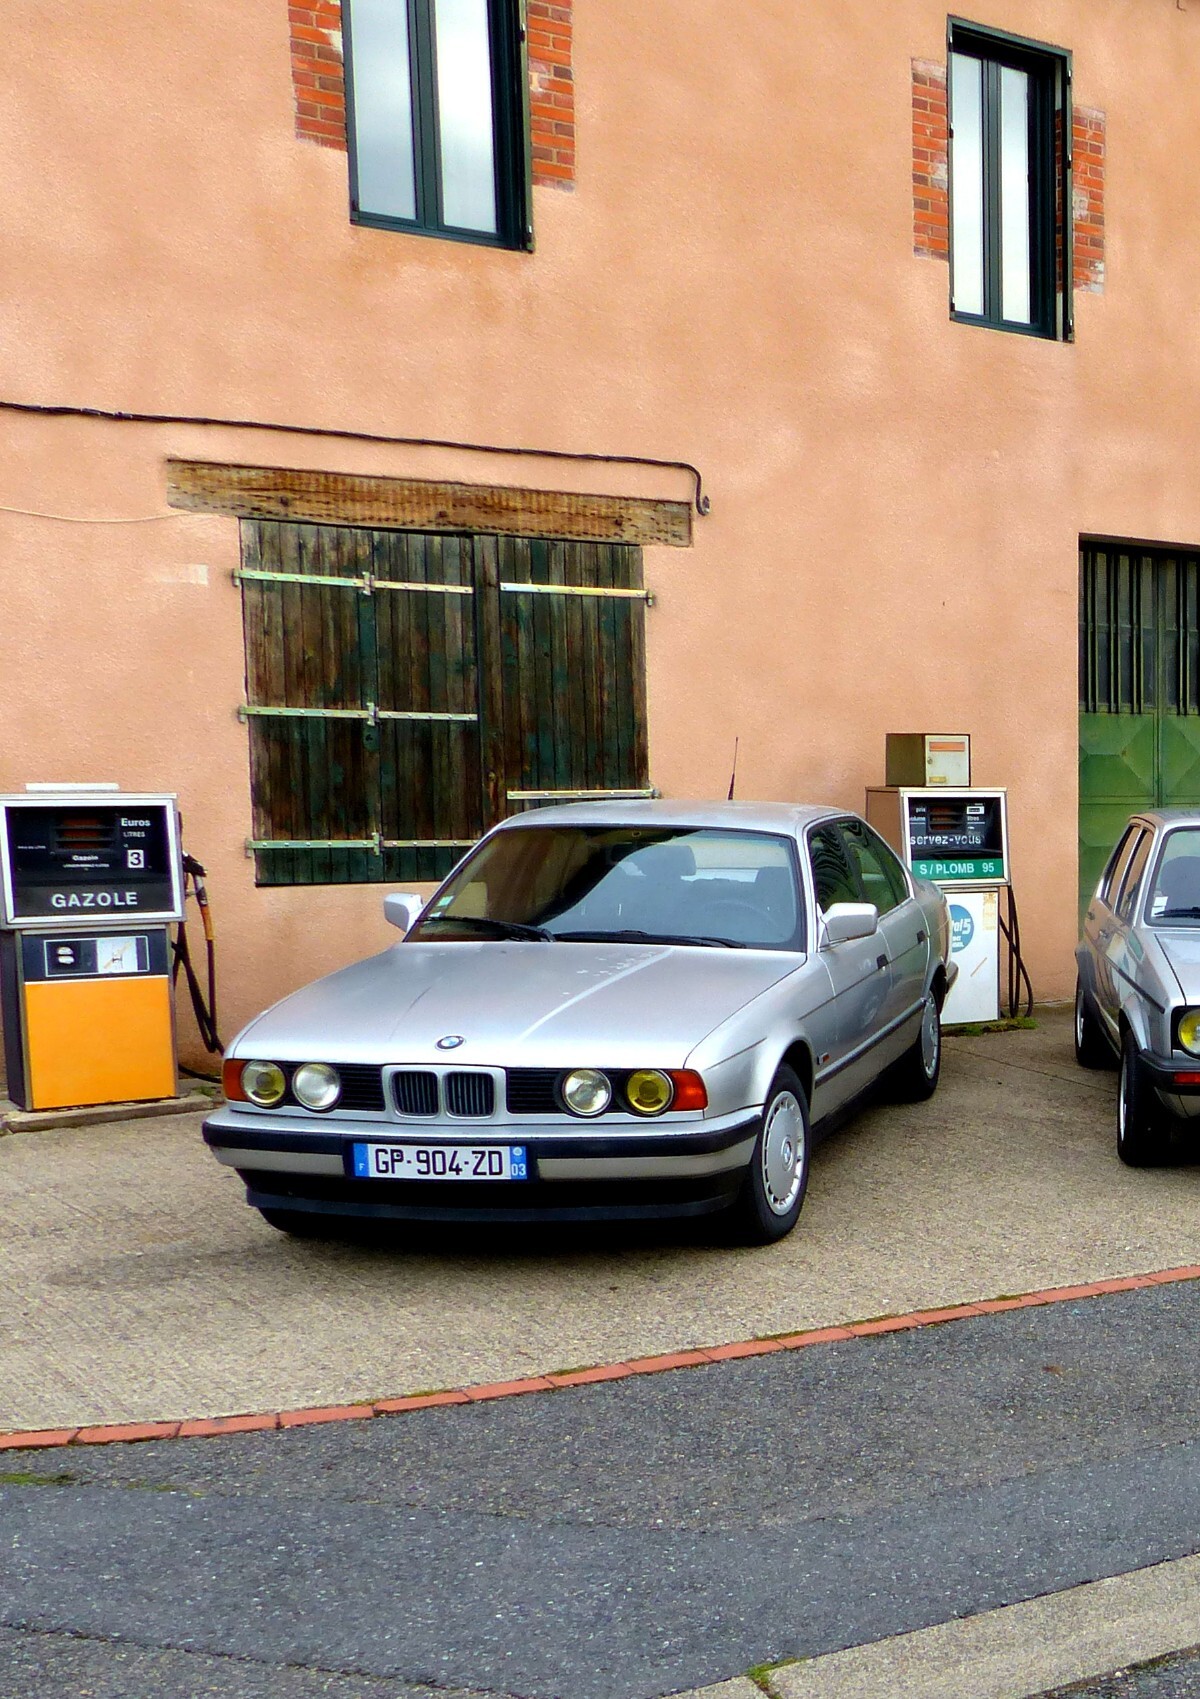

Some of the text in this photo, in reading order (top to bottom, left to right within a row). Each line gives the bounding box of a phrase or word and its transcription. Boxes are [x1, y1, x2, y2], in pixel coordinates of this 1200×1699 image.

[121, 817, 151, 827] Euros
[910, 834, 982, 846] servez-vous
[130, 851, 142, 866] 3
[982, 862, 995, 873] 95
[52, 891, 138, 908] GAZOLE
[375, 1148, 503, 1176] GP-904-ZD
[511, 1163, 526, 1176] 03
